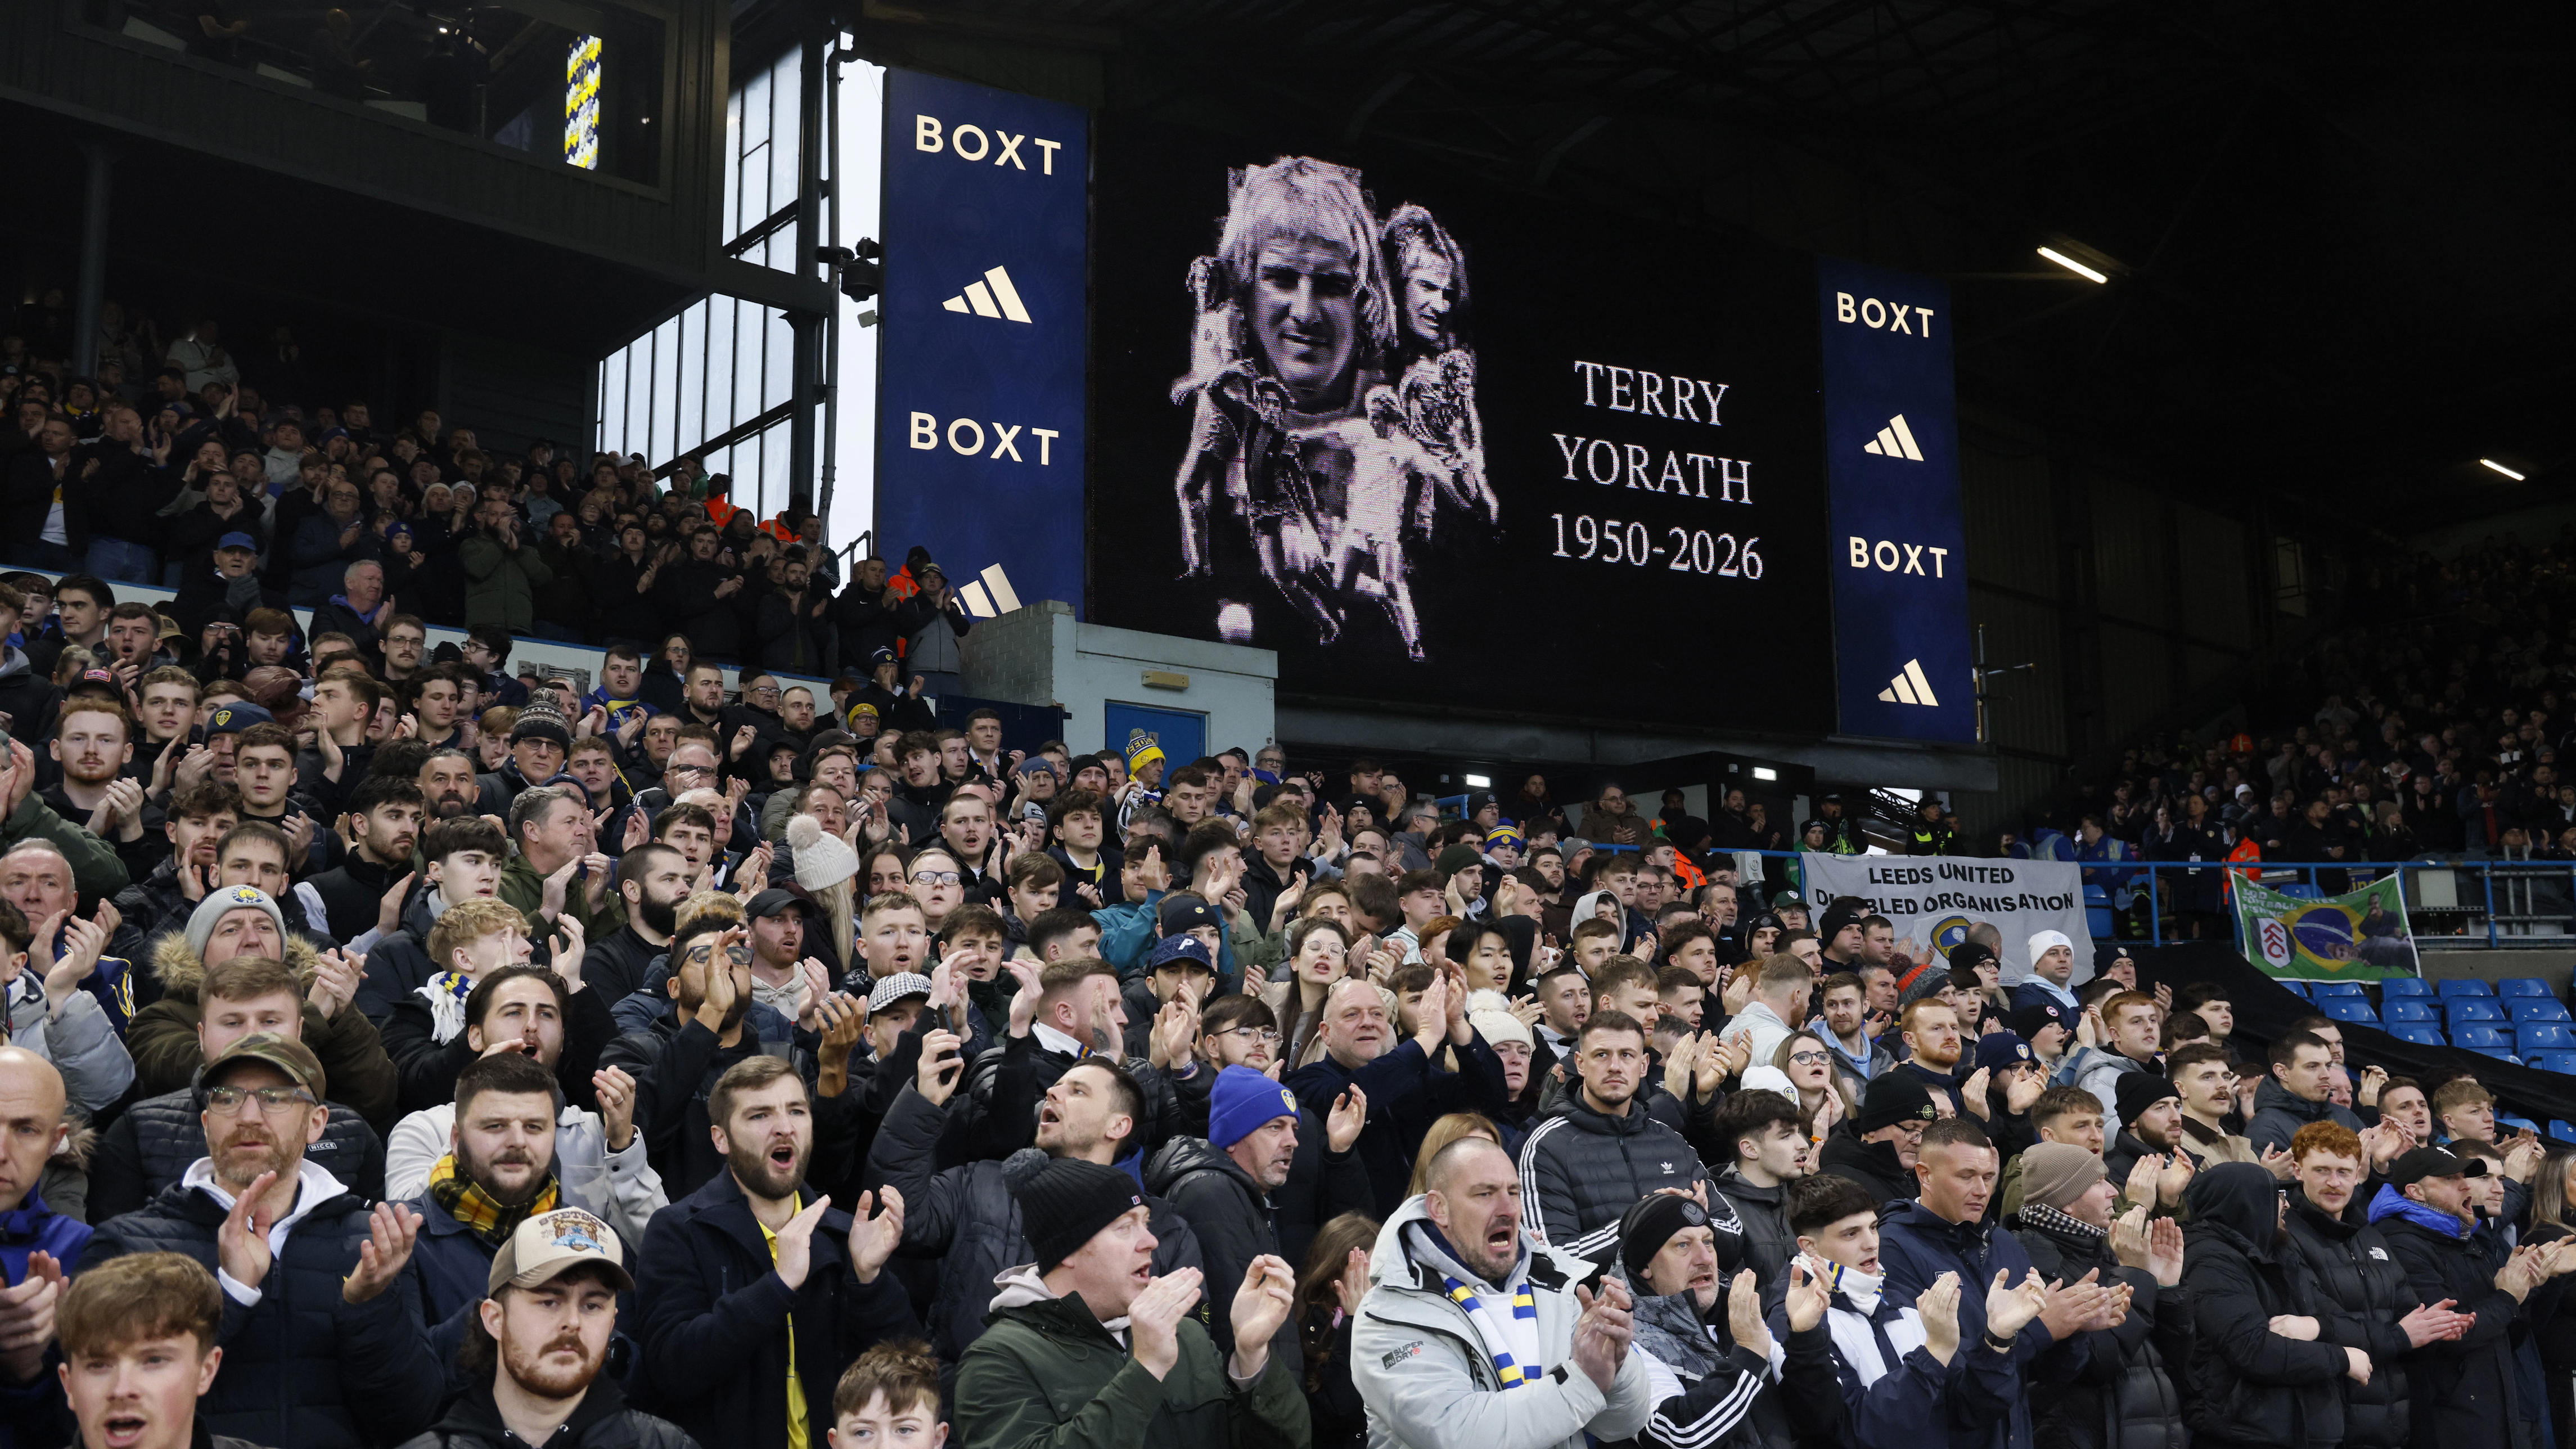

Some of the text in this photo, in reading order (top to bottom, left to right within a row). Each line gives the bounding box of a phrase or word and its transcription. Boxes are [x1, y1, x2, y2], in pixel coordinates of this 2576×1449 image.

[916, 114, 1061, 176] BOXT
[1837, 291, 1934, 338] BOXT
[1574, 360, 1730, 426] TERRY
[910, 411, 1059, 466] BOXT
[1551, 433, 1753, 505] YORATH
[1551, 513, 1763, 580] 1950-2026
[1849, 536, 1948, 578] BOXT
[1128, 738, 1152, 753] EEDS
[1869, 862, 2015, 885] LEEDS UNITED
[1816, 889, 2074, 914] DIBLED ORGANISATION
[1178, 938, 1195, 950] P
[1393, 1340, 1425, 1356] SUPER
